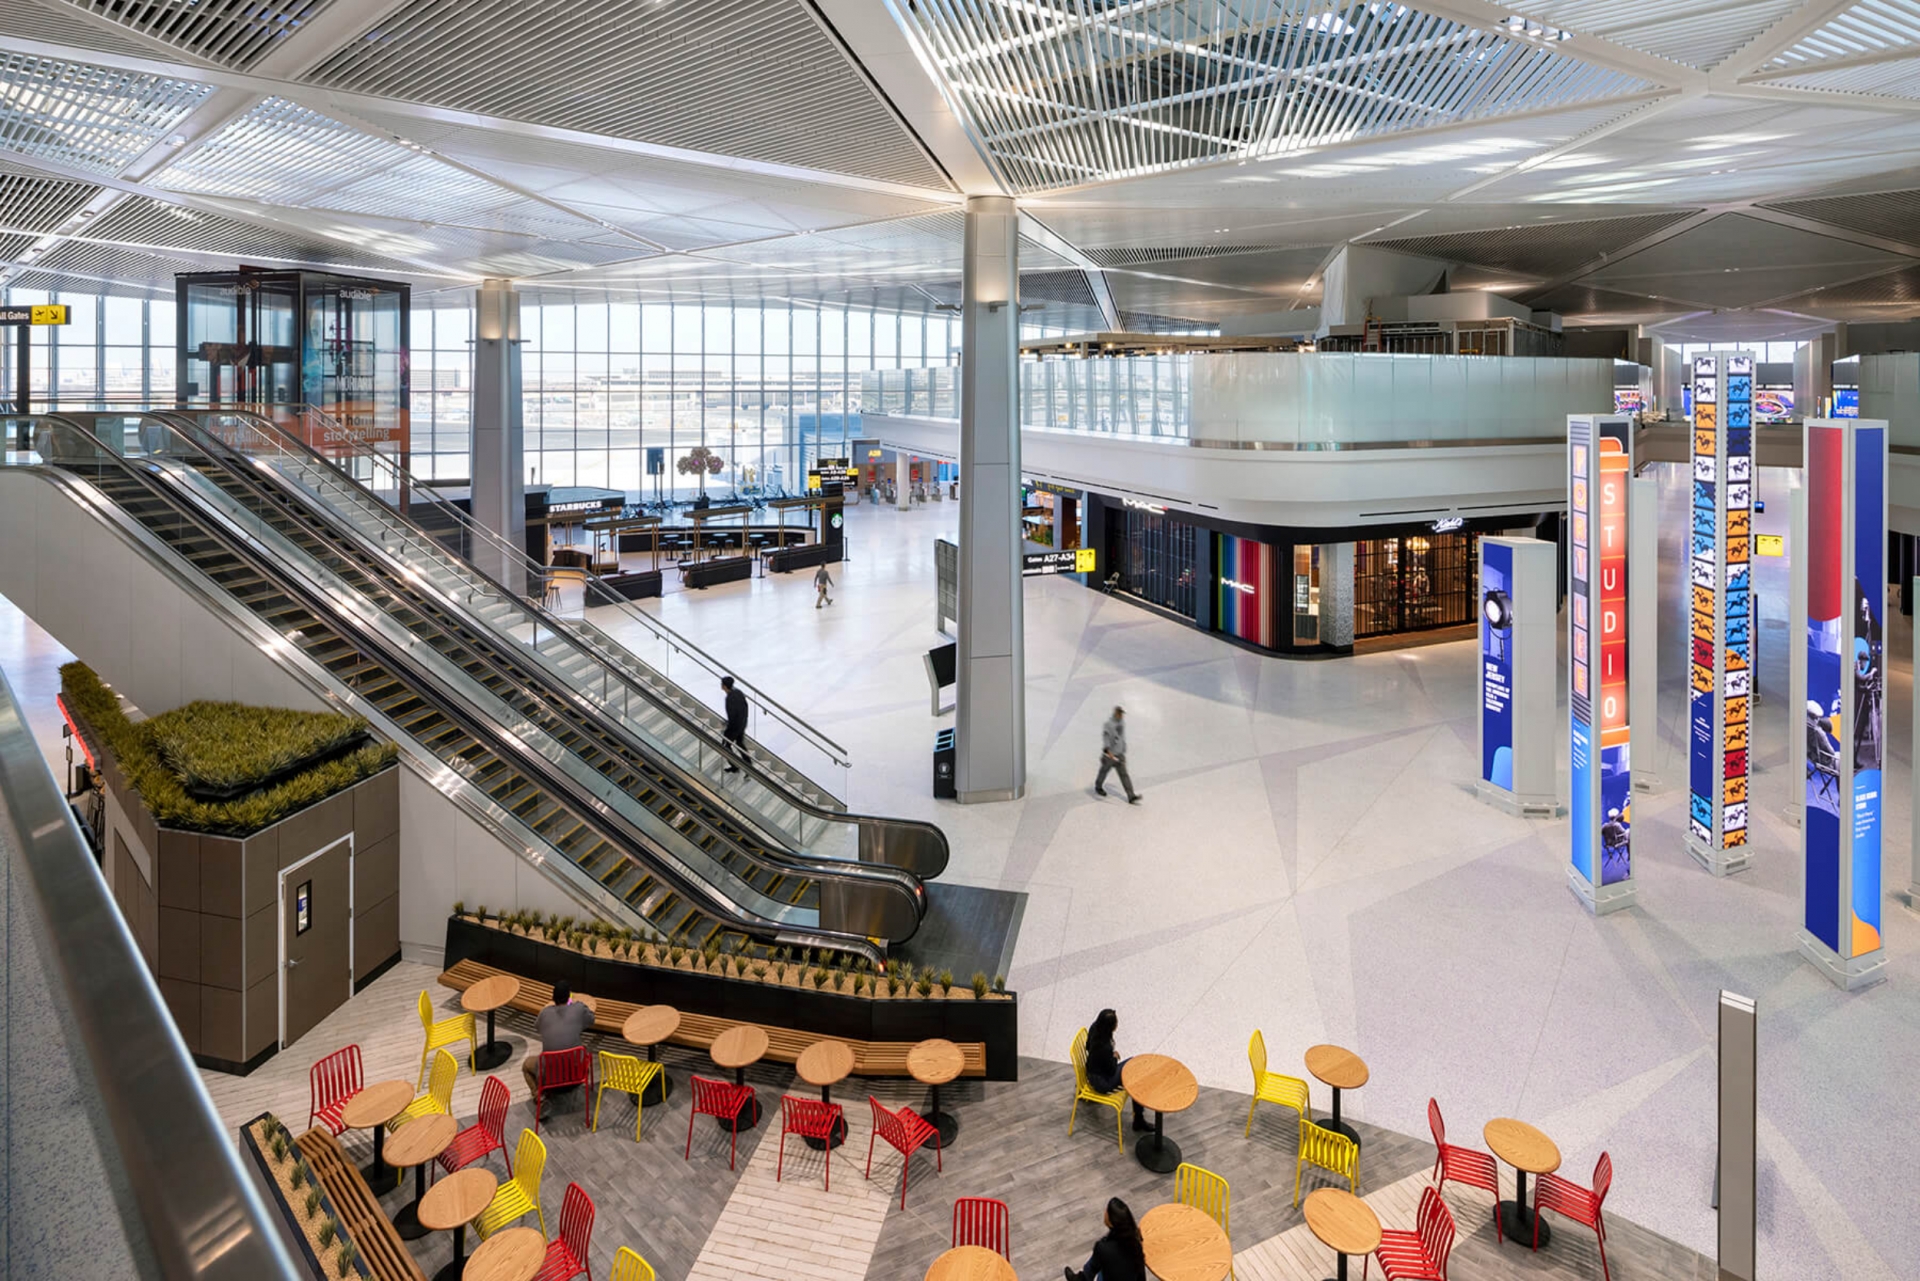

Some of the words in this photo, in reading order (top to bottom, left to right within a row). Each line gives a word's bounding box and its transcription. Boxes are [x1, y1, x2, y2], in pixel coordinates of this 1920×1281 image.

[219, 285, 252, 296] audible
[339, 288, 372, 300] audible
[8, 311, 30, 320] Gates
[549, 500, 602, 513] STARBUCKS
[1043, 552, 1076, 563] A27-A34
[1603, 482, 1616, 718] STUDIO
